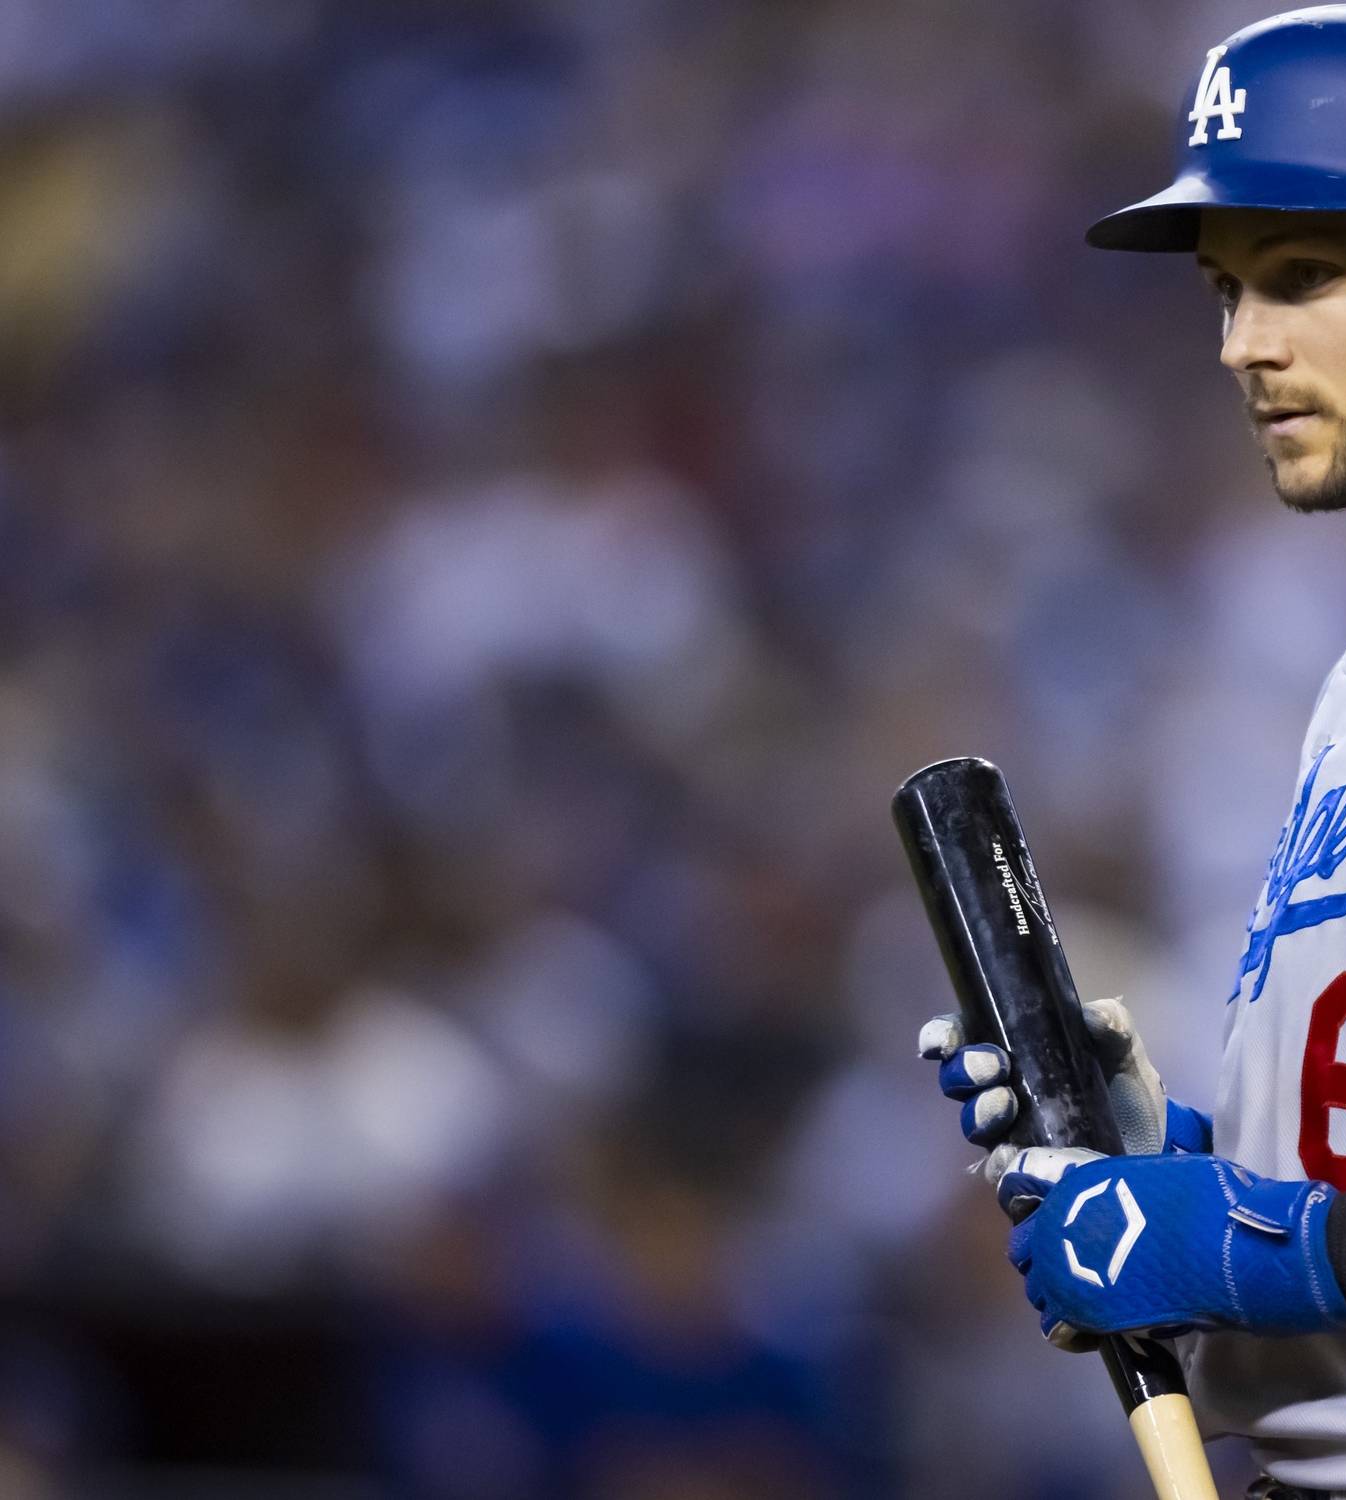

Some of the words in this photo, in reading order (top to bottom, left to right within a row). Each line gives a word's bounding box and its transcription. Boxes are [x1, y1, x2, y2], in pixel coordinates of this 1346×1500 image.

[1188, 45, 1247, 147] LA
[992, 842, 1006, 862] For
[996, 864, 1030, 936] Handcrafted
